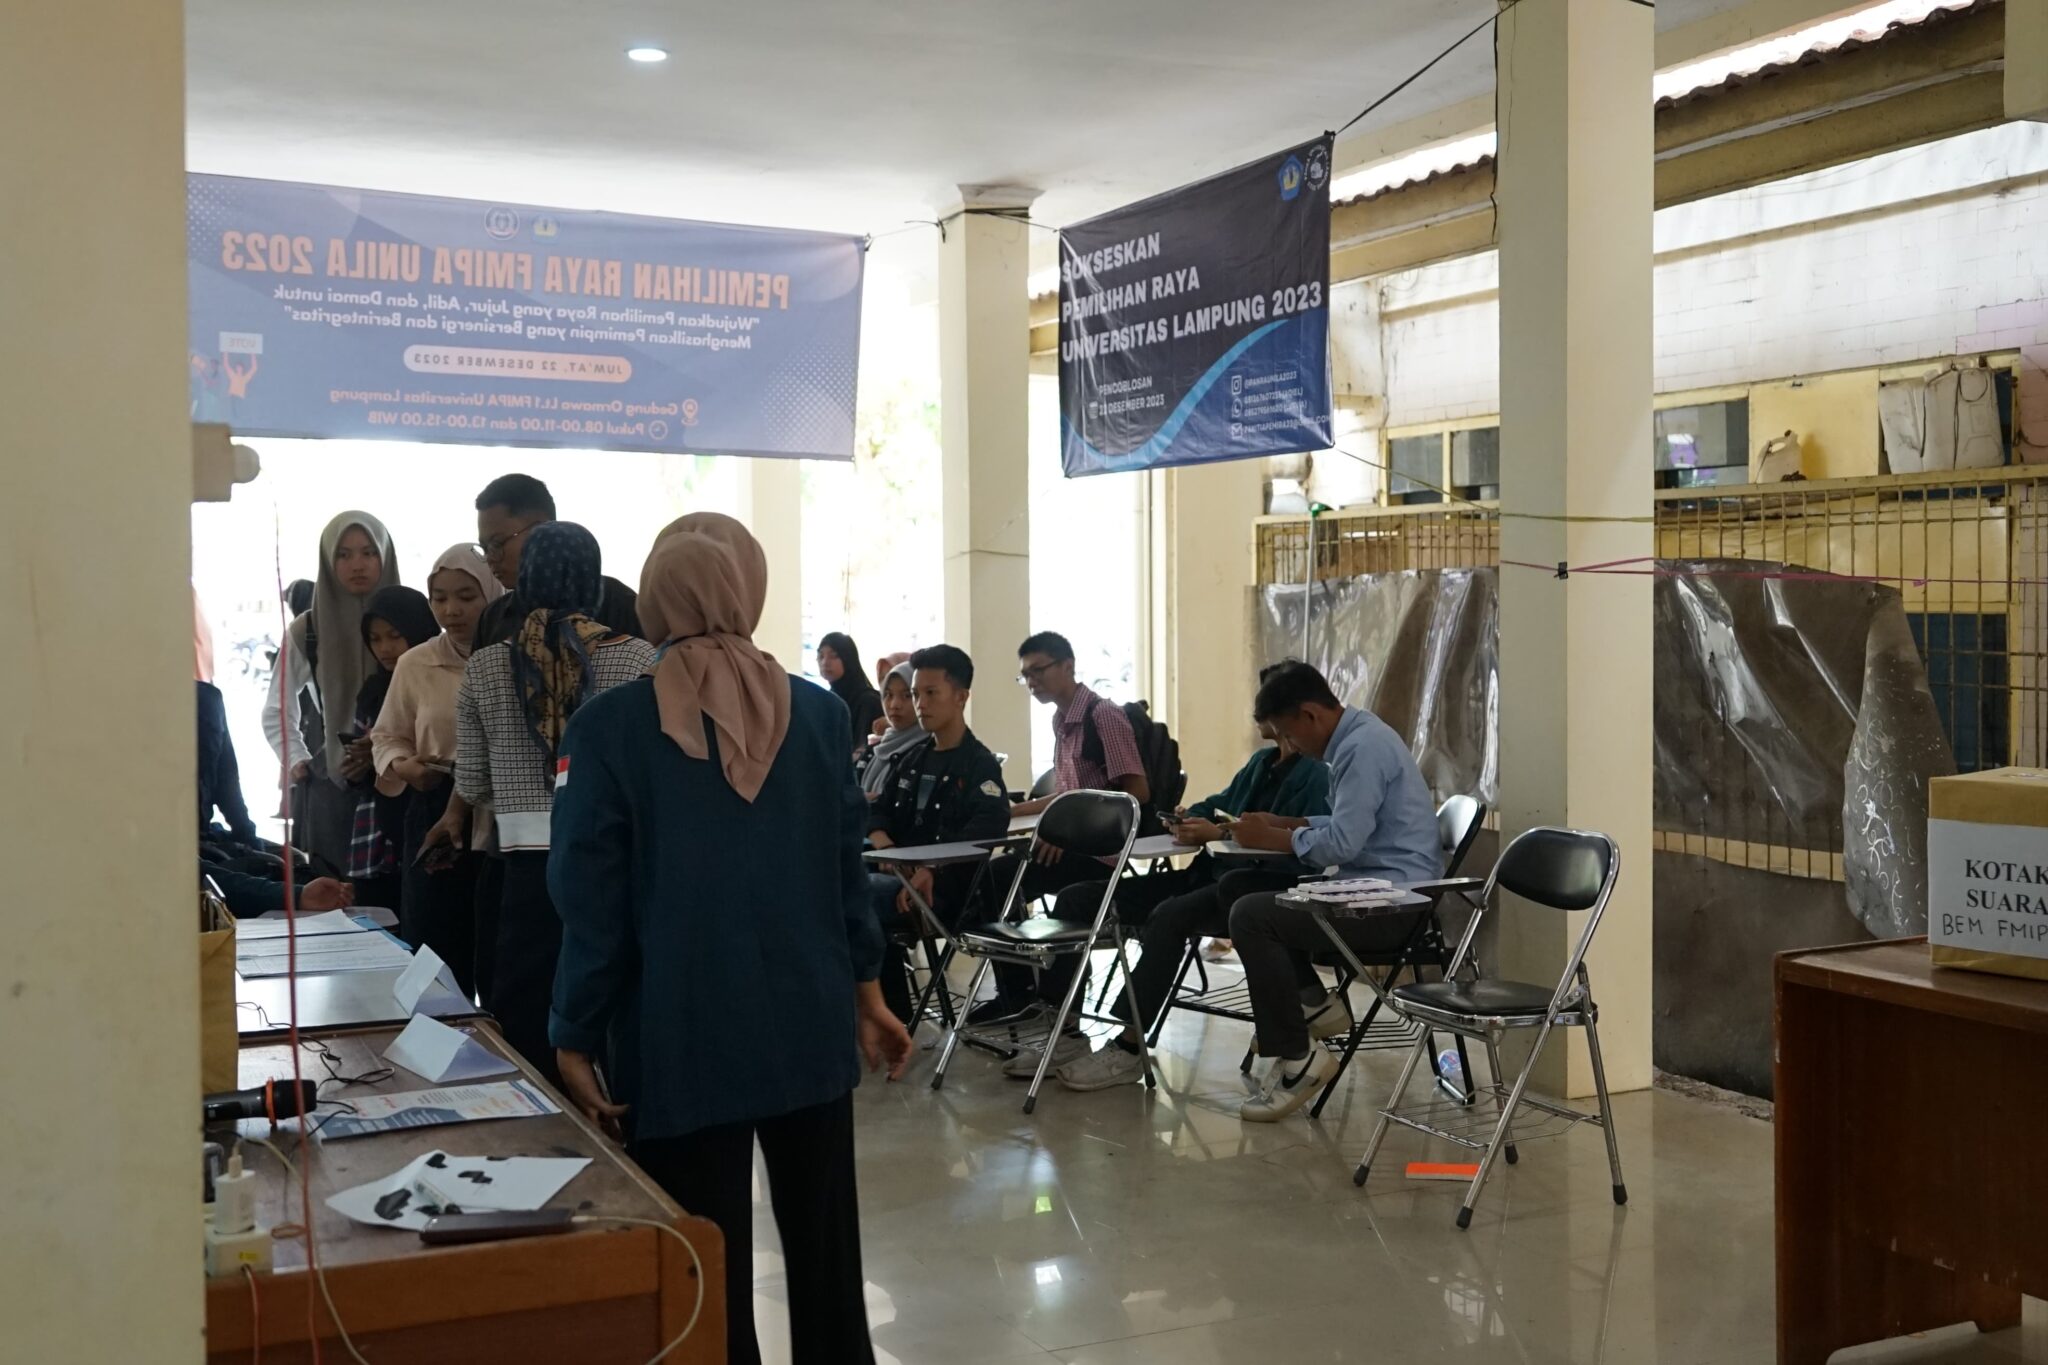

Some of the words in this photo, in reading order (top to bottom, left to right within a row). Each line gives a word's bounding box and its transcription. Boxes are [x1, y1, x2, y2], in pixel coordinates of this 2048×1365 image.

[1062, 232, 1160, 283] SUKSESKAN
[1062, 280, 1147, 323] PEMILIHAN
[1152, 266, 1201, 300] RAYA
[1062, 318, 1168, 362] UNIVERSITAS
[1173, 294, 1266, 338] LAMPUNG
[1272, 281, 1322, 316] 2023
[1965, 858, 2048, 886] KOTAK
[1966, 888, 2048, 916] SUARA
[1942, 913, 1984, 936] BEM
[1998, 919, 2048, 942] FMIP
